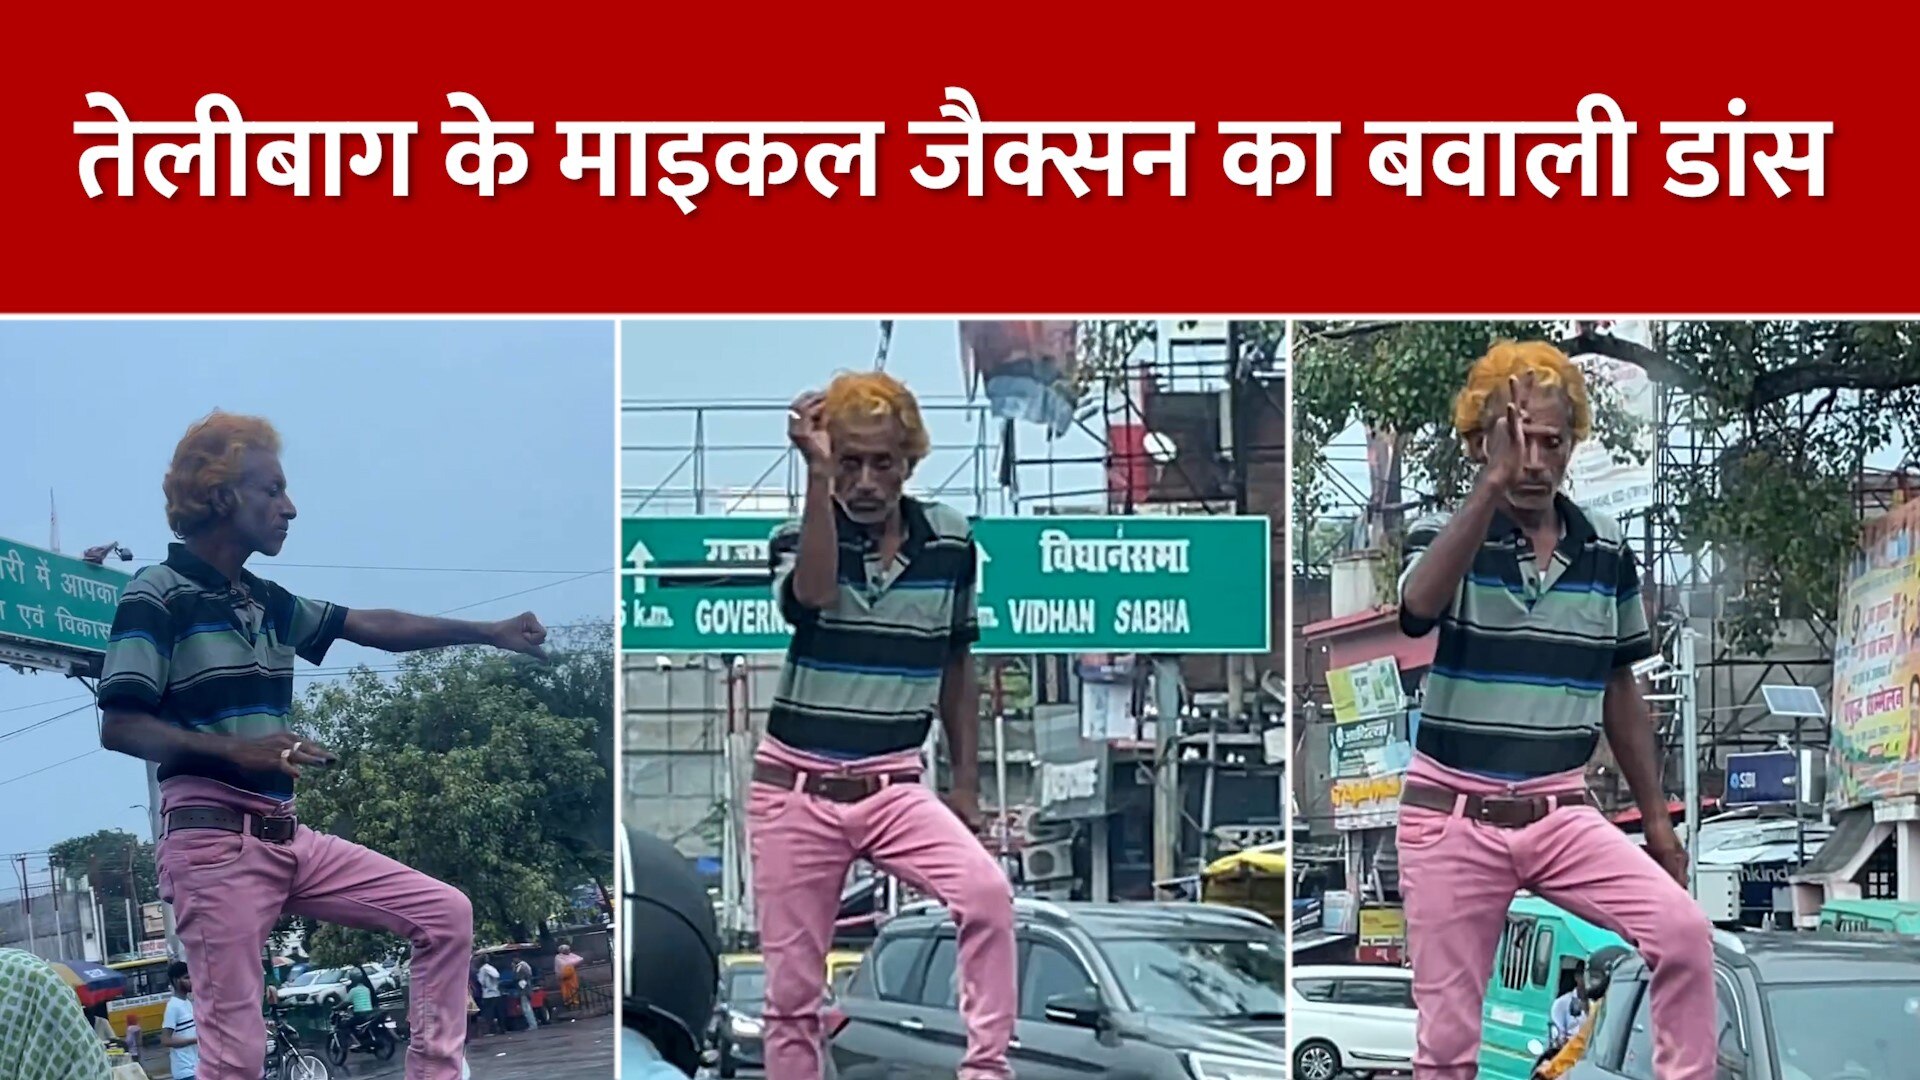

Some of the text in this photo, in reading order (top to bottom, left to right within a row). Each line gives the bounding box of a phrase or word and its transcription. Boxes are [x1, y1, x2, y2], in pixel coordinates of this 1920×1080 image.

[0, 549, 119, 607] री में आपका
[16, 604, 45, 629] एवं
[55, 606, 113, 640] विकास
[695, 599, 797, 635] GOVERN
[1008, 599, 1190, 634] VIDHAN SABHA
[1740, 865, 1789, 882] nkind
